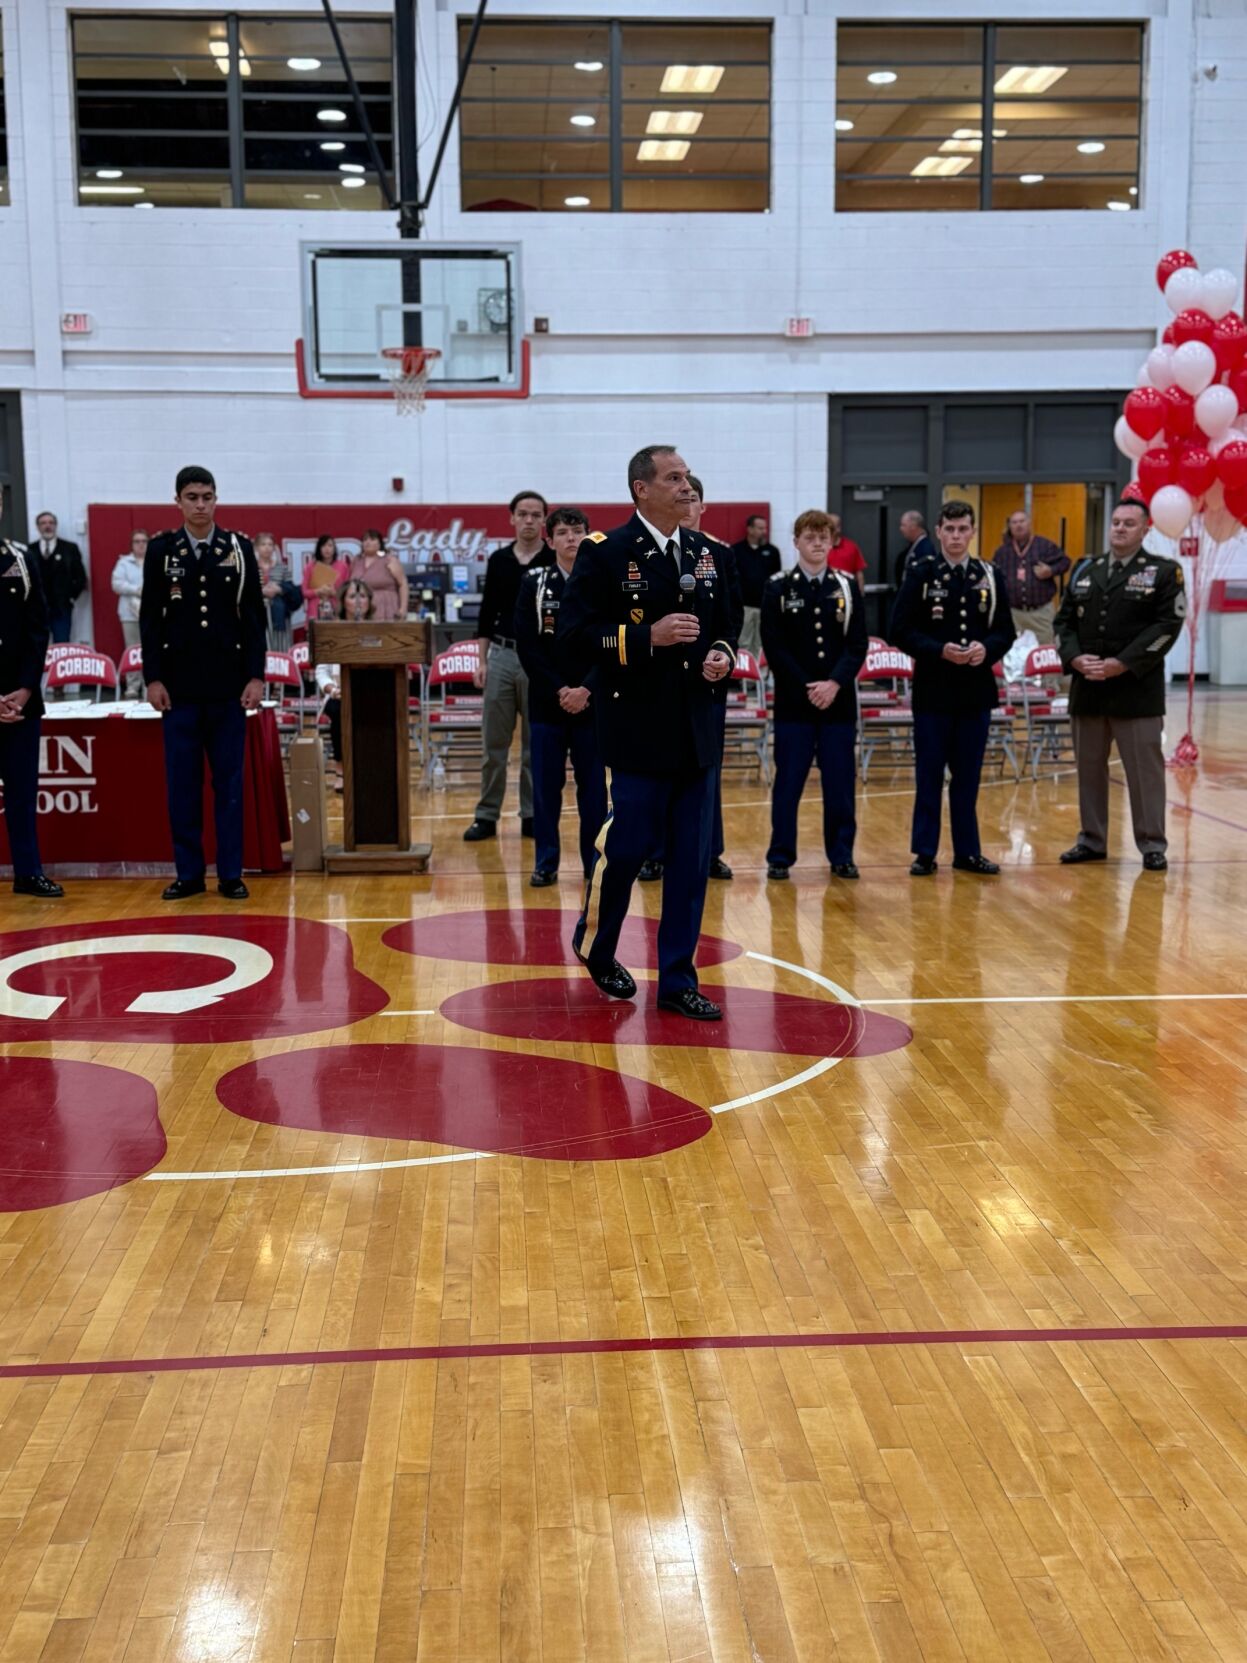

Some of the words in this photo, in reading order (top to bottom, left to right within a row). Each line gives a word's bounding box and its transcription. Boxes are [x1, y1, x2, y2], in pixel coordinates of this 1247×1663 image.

[385, 517, 488, 558] Lady
[56, 657, 106, 679] CORBIN
[866, 651, 912, 671] CORBIN
